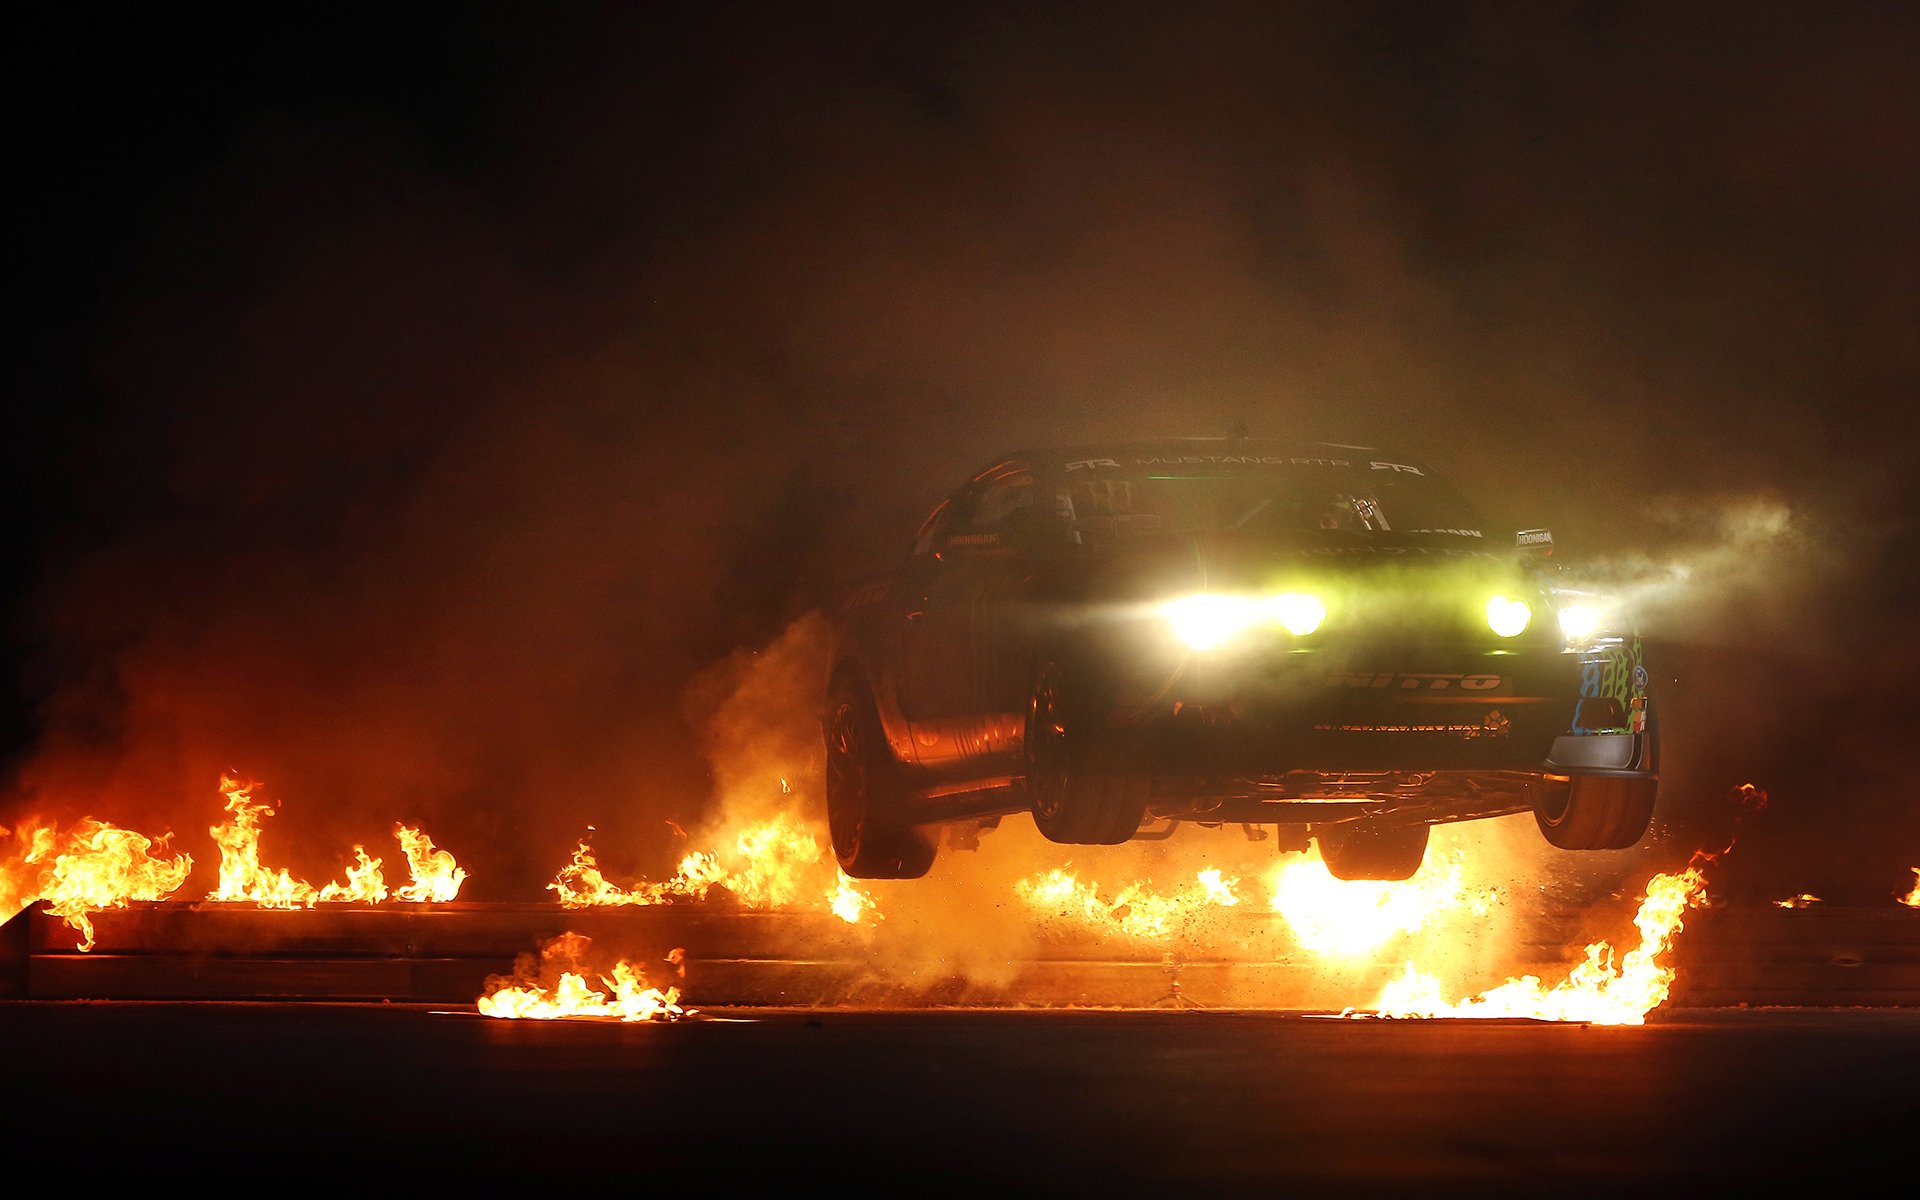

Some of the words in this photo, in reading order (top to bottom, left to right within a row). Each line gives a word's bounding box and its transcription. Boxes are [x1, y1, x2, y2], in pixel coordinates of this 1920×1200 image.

[1136, 456, 1282, 465] MUSTANG
[1291, 457, 1350, 466] RTR
[1518, 531, 1553, 545] HOONIGAN
[1326, 671, 1501, 690] NITTO
